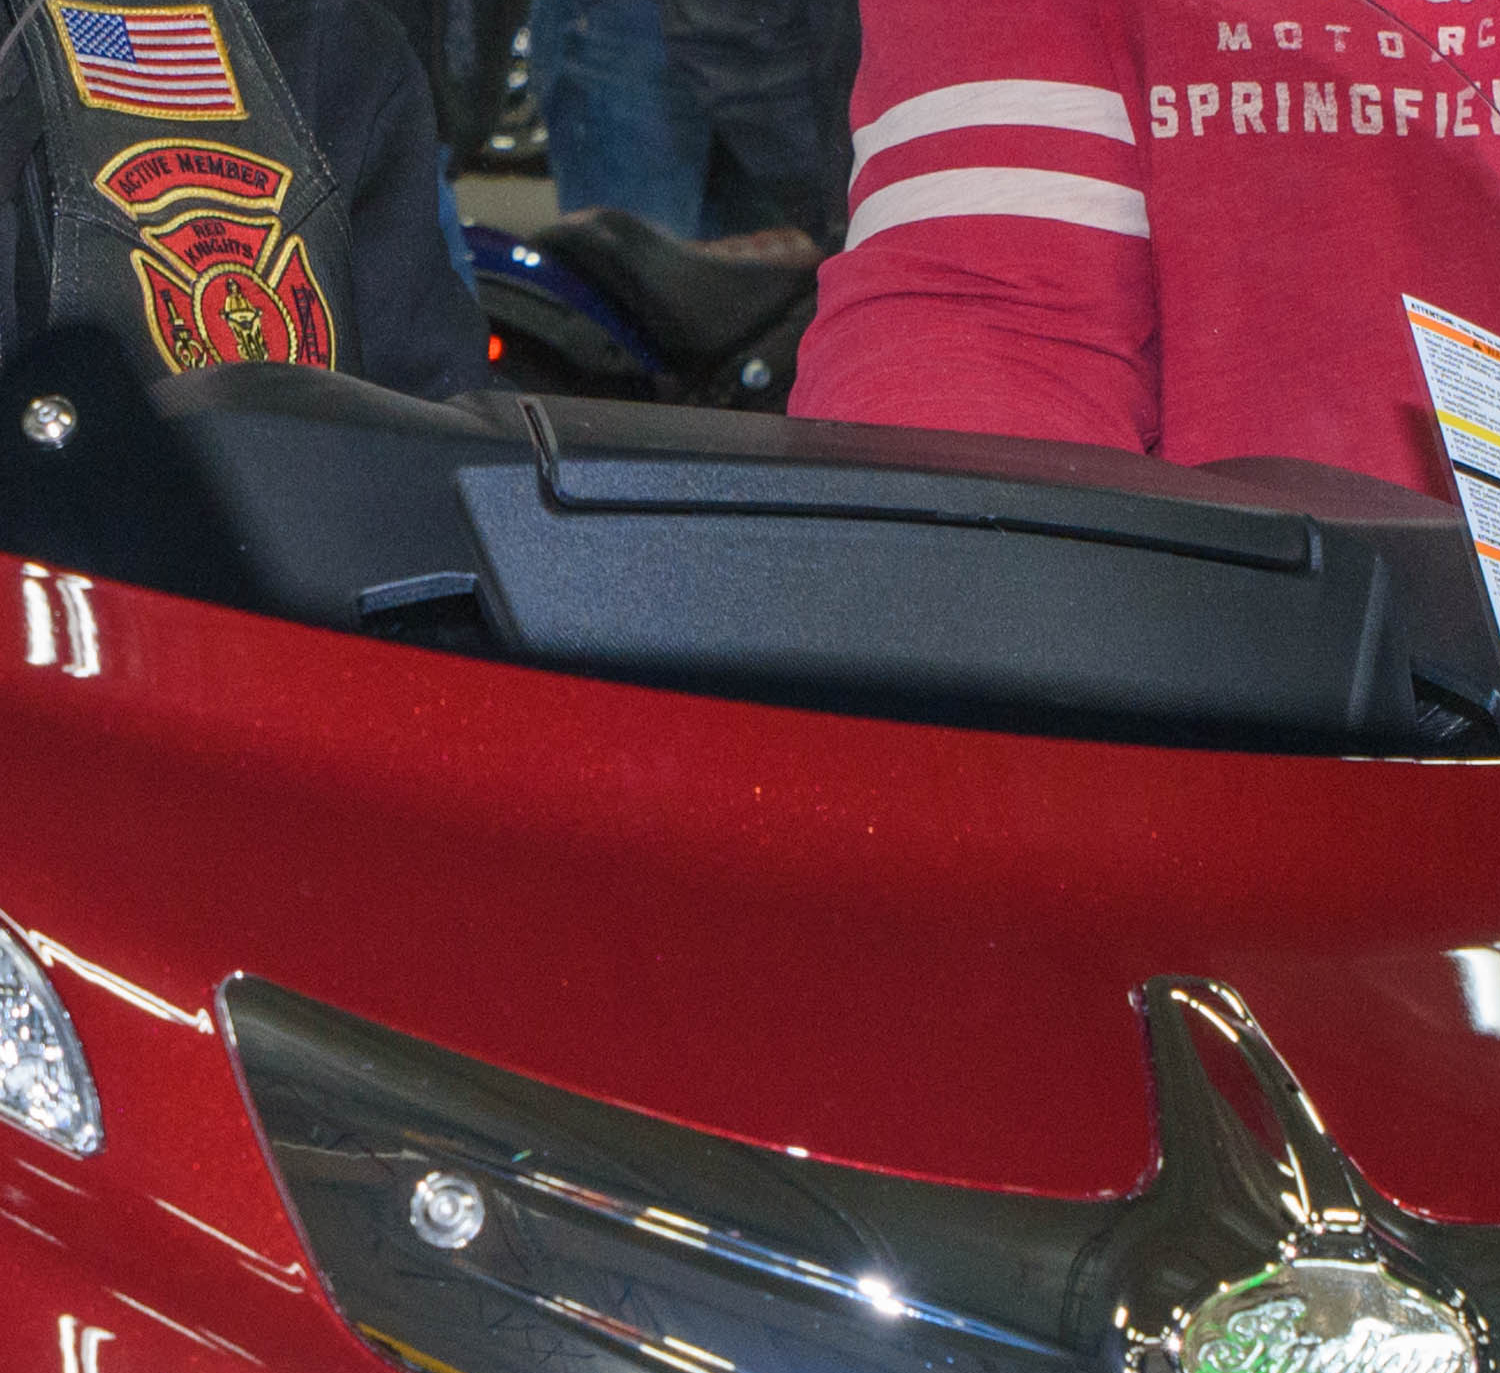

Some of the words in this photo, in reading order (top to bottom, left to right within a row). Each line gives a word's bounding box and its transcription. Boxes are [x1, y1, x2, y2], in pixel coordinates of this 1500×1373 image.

[117, 155, 172, 197] ACTIVE
[176, 153, 269, 191] MEMBER
[191, 221, 226, 239] RED
[184, 237, 254, 265] KNIGHTS
